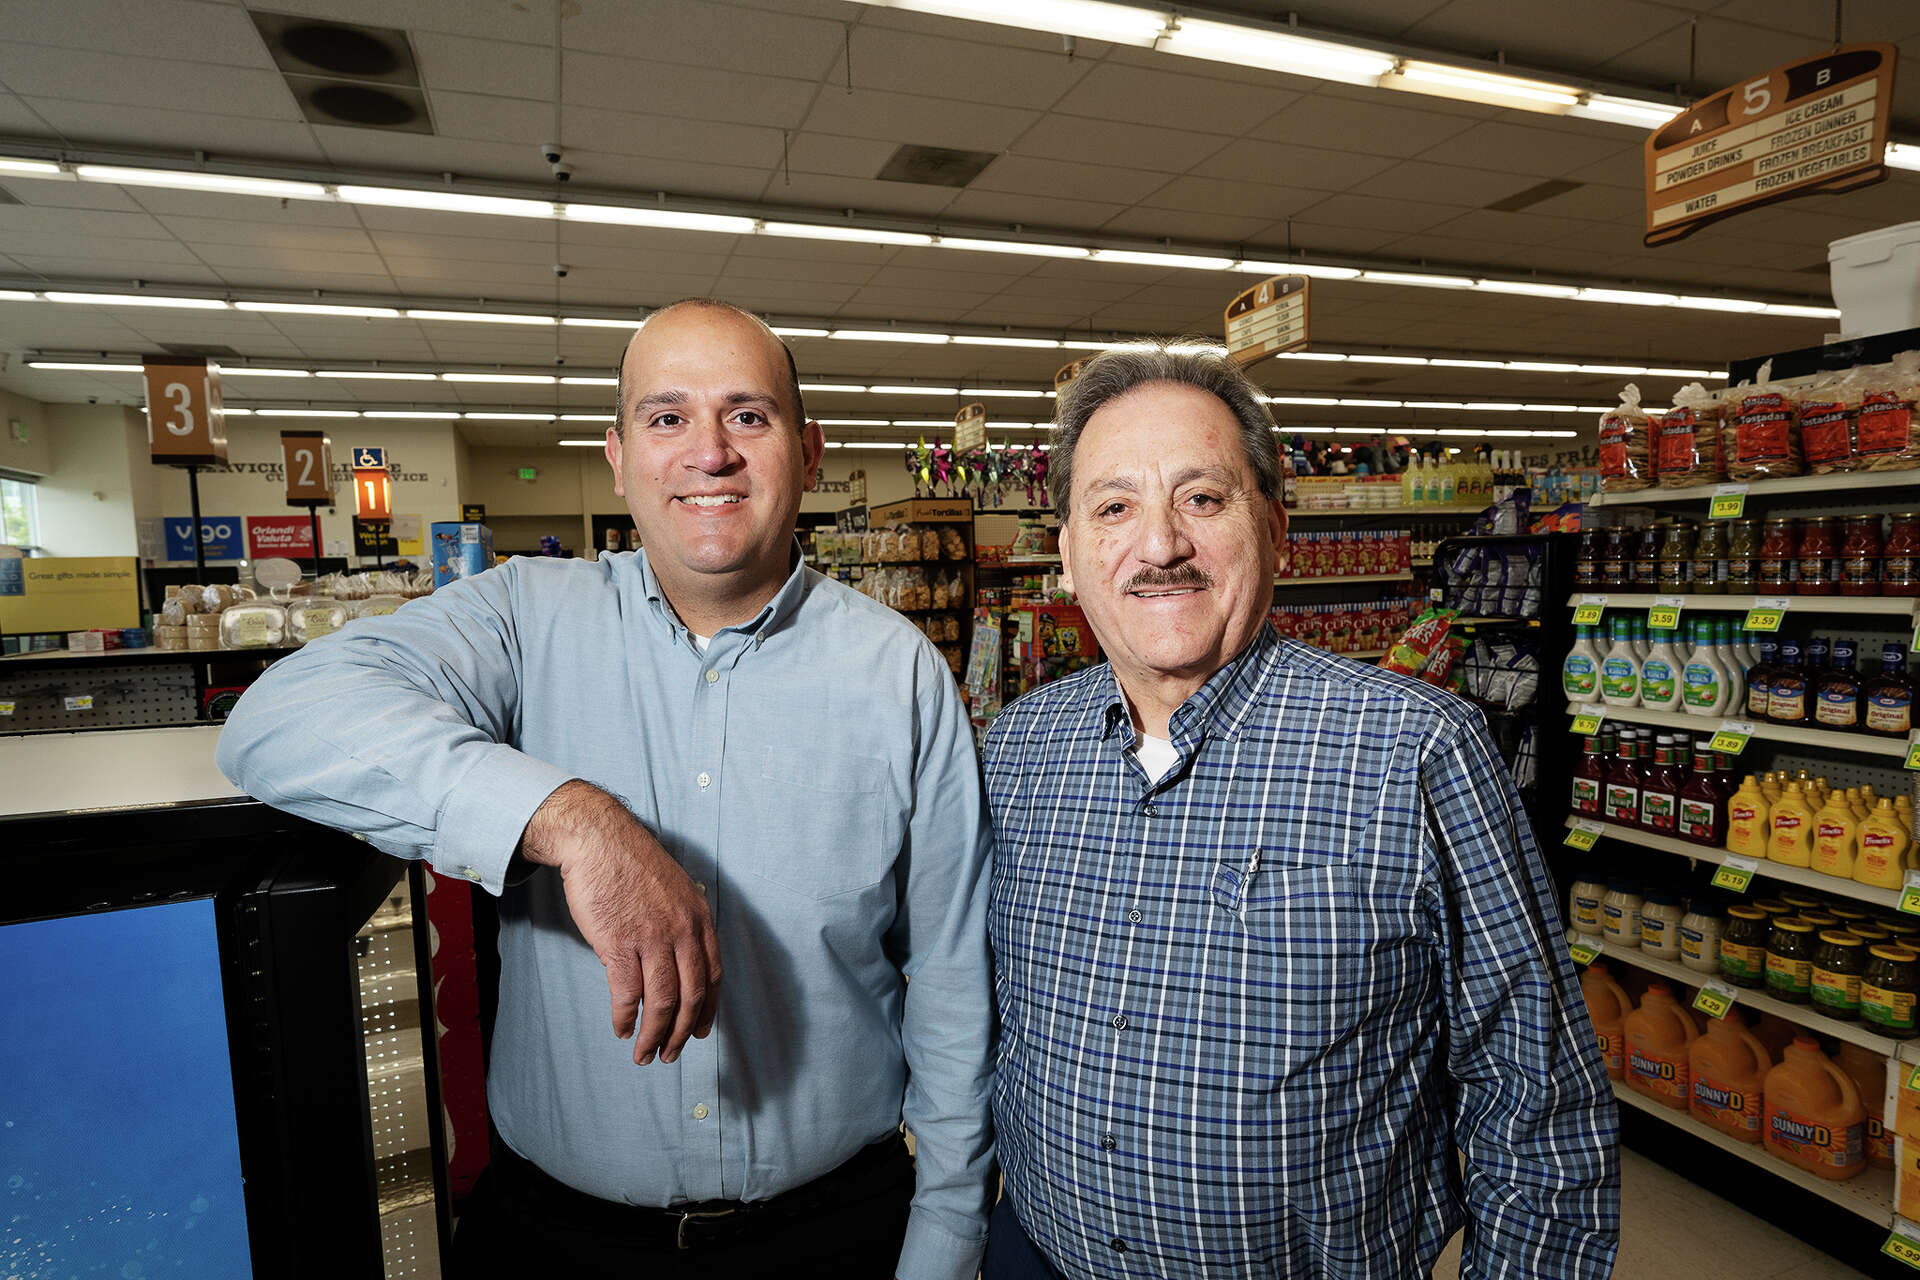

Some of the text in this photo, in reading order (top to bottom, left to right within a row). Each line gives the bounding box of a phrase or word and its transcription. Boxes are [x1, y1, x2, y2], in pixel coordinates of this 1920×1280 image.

[1816, 68, 1831, 86] B
[1743, 76, 1771, 116] 5
[1785, 93, 1844, 126] ICE CREAM
[1690, 119, 1703, 134] A
[1770, 110, 1857, 150] FROZEN DINNER
[1691, 138, 1719, 159] JUICE
[1759, 126, 1867, 171] FROZEN BREAKFAST
[1666, 148, 1743, 185] POWDER DRINKS
[1755, 146, 1867, 193] FROZEN VEGETABLES
[1684, 194, 1718, 213] WATER
[1258, 283, 1269, 305] 4
[1239, 302, 1247, 312] A
[164, 382, 195, 436] 3
[1739, 411, 1786, 426] Tostadas
[295, 448, 316, 486] 2
[364, 480, 377, 510] 1
[252, 525, 294, 536] Orlandi
[256, 533, 293, 543] Valuta
[29, 572, 54, 580] Great
[56, 571, 74, 581] gifts
[76, 571, 101, 579] made
[1820, 706, 1850, 715] Original
[1871, 711, 1904, 720] Original
